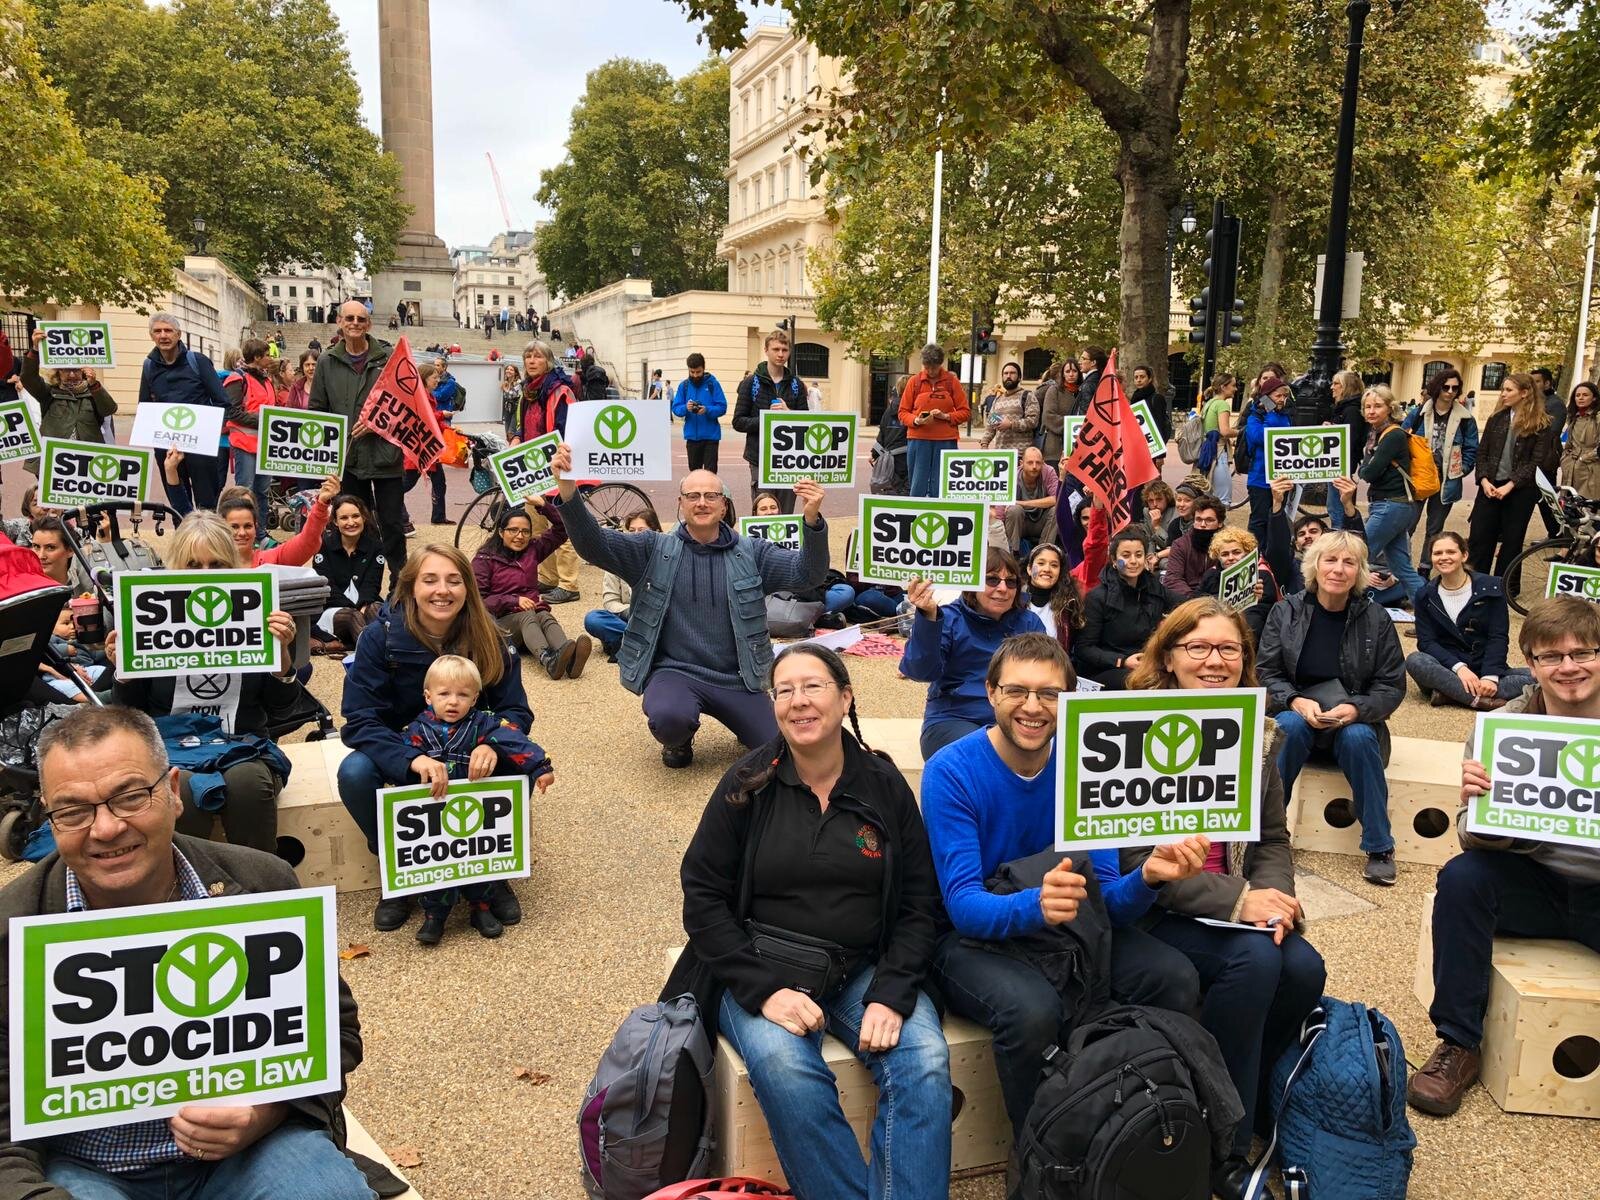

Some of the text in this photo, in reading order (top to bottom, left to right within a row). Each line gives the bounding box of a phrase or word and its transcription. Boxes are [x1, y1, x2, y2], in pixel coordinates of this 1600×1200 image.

[47, 328, 104, 347] STOP
[48, 347, 106, 356] ECOCIDE
[368, 406, 390, 430] IS
[154, 431, 198, 444] EARTH
[270, 420, 339, 449] STOP
[772, 423, 849, 455] STOP
[19, 445, 37, 456] law
[268, 445, 338, 464] ECOCIDE
[1274, 435, 1340, 458] STOP
[54, 453, 140, 482] STOP
[264, 460, 339, 474] change the law
[502, 444, 557, 478] STOP
[588, 452, 644, 466] EARTH
[771, 454, 847, 469] ECOCIDE
[949, 458, 1008, 480] STOP
[1274, 457, 1340, 470] ECOCIDE
[509, 466, 554, 491] ECOCI
[588, 467, 645, 476] PROTECTORS
[768, 472, 848, 483] change the law
[52, 478, 138, 498] ECOCIDE
[948, 481, 1008, 491] ECOCIDE
[48, 493, 94, 506] change
[748, 523, 799, 541] STOP
[873, 512, 973, 549] STOP
[872, 546, 971, 567] ECOCIDE
[869, 565, 974, 583] change the law
[1224, 563, 1256, 598] STOP
[135, 585, 262, 627] STOP
[135, 627, 262, 650] ECOCIDE
[131, 650, 267, 670] change the law
[191, 705, 221, 717] NON
[1081, 713, 1240, 775] STOP
[1080, 774, 1236, 810] ECOCIDE
[396, 795, 512, 842] STOP
[1073, 809, 1242, 837] change the law
[1485, 808, 1569, 833] change
[397, 833, 512, 868] ECOCIDE
[394, 858, 517, 887] change the law
[51, 931, 304, 1025] STOP
[51, 1005, 304, 1078] ECOCIDE
[41, 1056, 314, 1116] change the law
